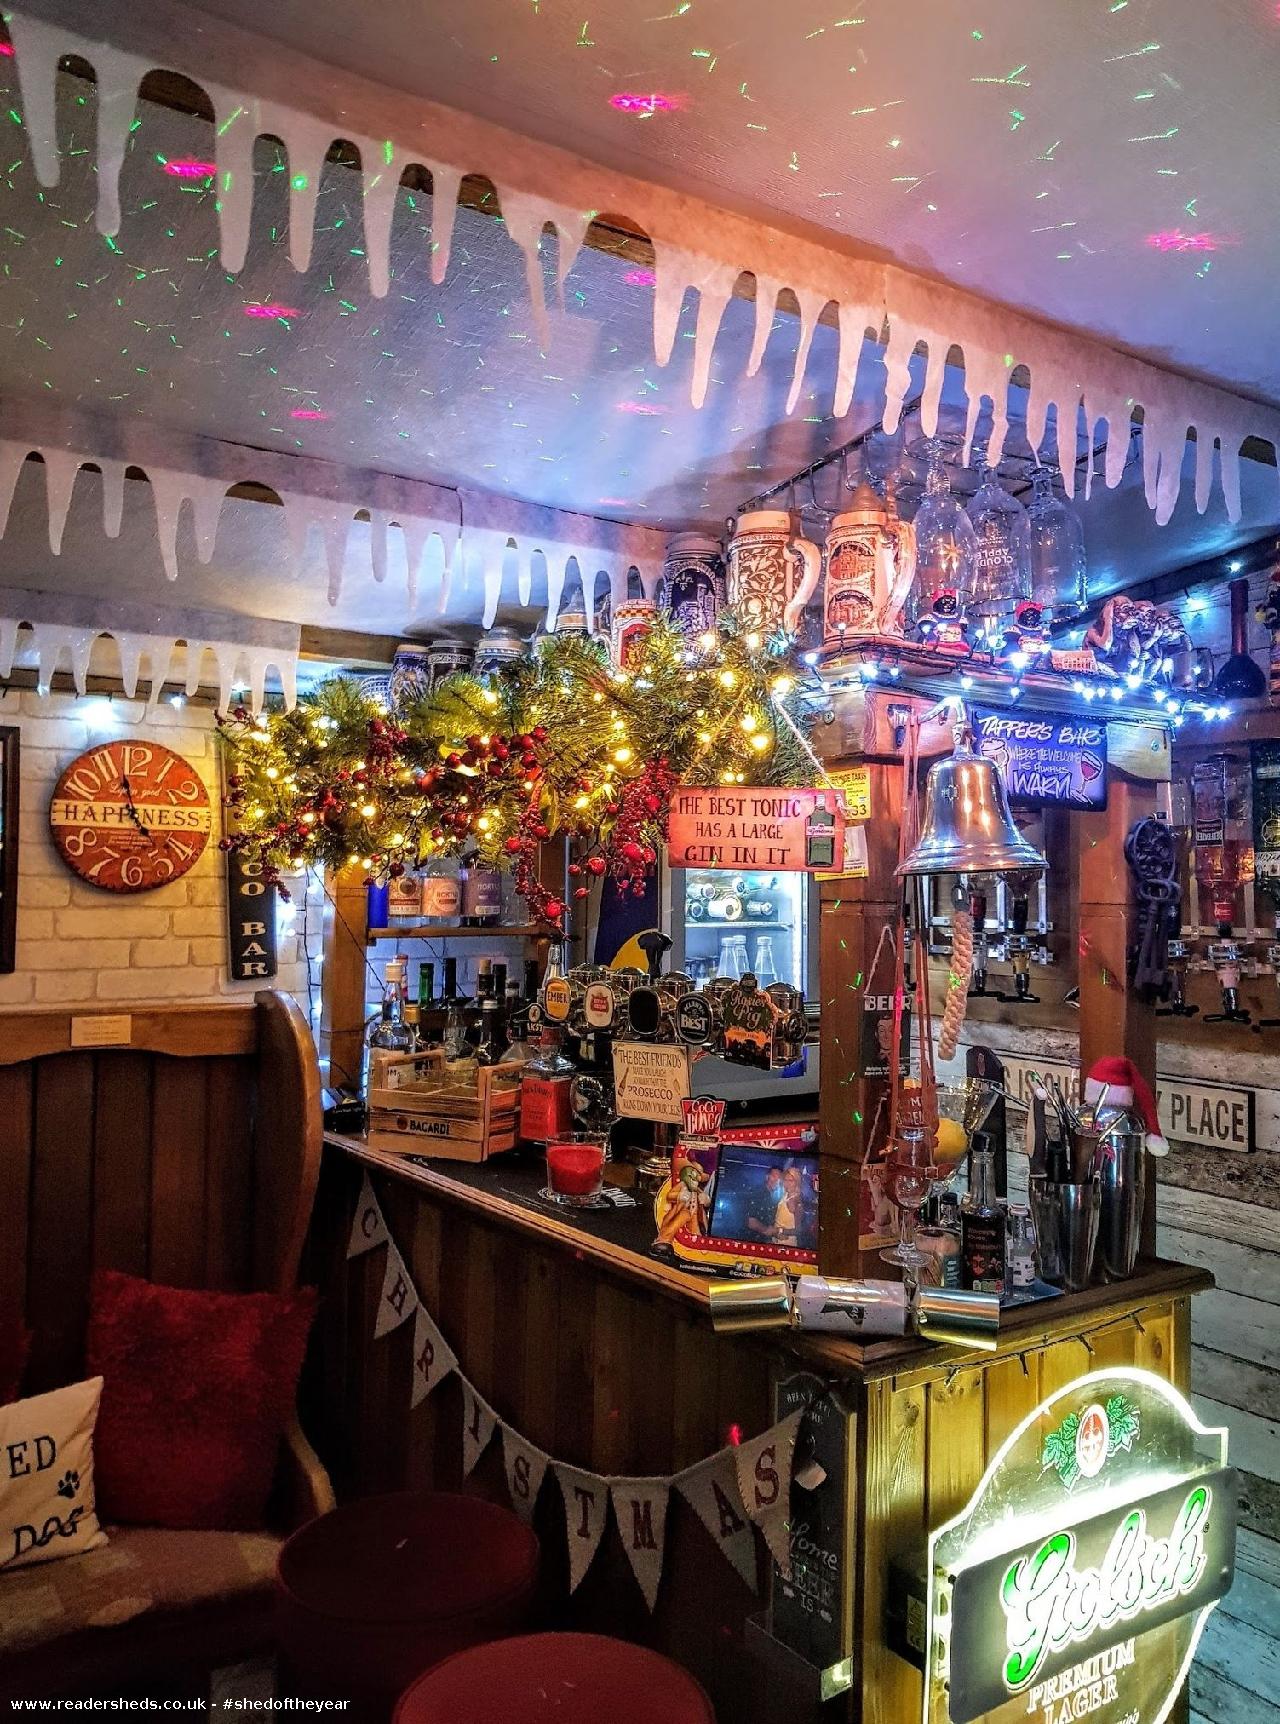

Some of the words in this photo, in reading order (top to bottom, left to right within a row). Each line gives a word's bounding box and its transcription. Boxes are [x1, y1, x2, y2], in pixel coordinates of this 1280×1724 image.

[1058, 727, 1101, 746] BAR
[122, 745, 153, 777] 12
[155, 756, 178, 784] 1
[63, 768, 101, 801] 10
[167, 780, 199, 805] 2
[1013, 770, 1072, 800] WARM
[64, 803, 200, 827] HAPPNESS
[678, 796, 702, 815] THE
[709, 797, 747, 817] BEST
[751, 798, 801, 818] TONIC
[66, 828, 97, 857] 8
[696, 822, 721, 839] HAS
[727, 823, 737, 839] A
[742, 823, 784, 840] LARGE
[91, 846, 120, 876] 7
[166, 832, 197, 861] 4
[684, 844, 723, 863] GIN
[732, 846, 760, 865] IN
[766, 847, 791, 866] IT
[121, 856, 143, 886] 6
[148, 849, 174, 878] 5
[241, 921, 268, 977] BAR
[680, 1013, 708, 1031] BEST
[618, 1049, 633, 1065] THE
[634, 1050, 650, 1066] BEST
[651, 1052, 681, 1069] FRIENDS
[627, 1085, 673, 1100] PROSECCO
[409, 1119, 451, 1136] BACARDI
[1171, 1093, 1245, 1143] PLACE
[0, 1434, 57, 1479] ED
[12, 1505, 85, 1557] DOG
[1000, 1486, 1212, 1693] Grolsch
[1026, 1640, 1136, 1714] PREMIUM
[1043, 1674, 1119, 1724] LAGER
